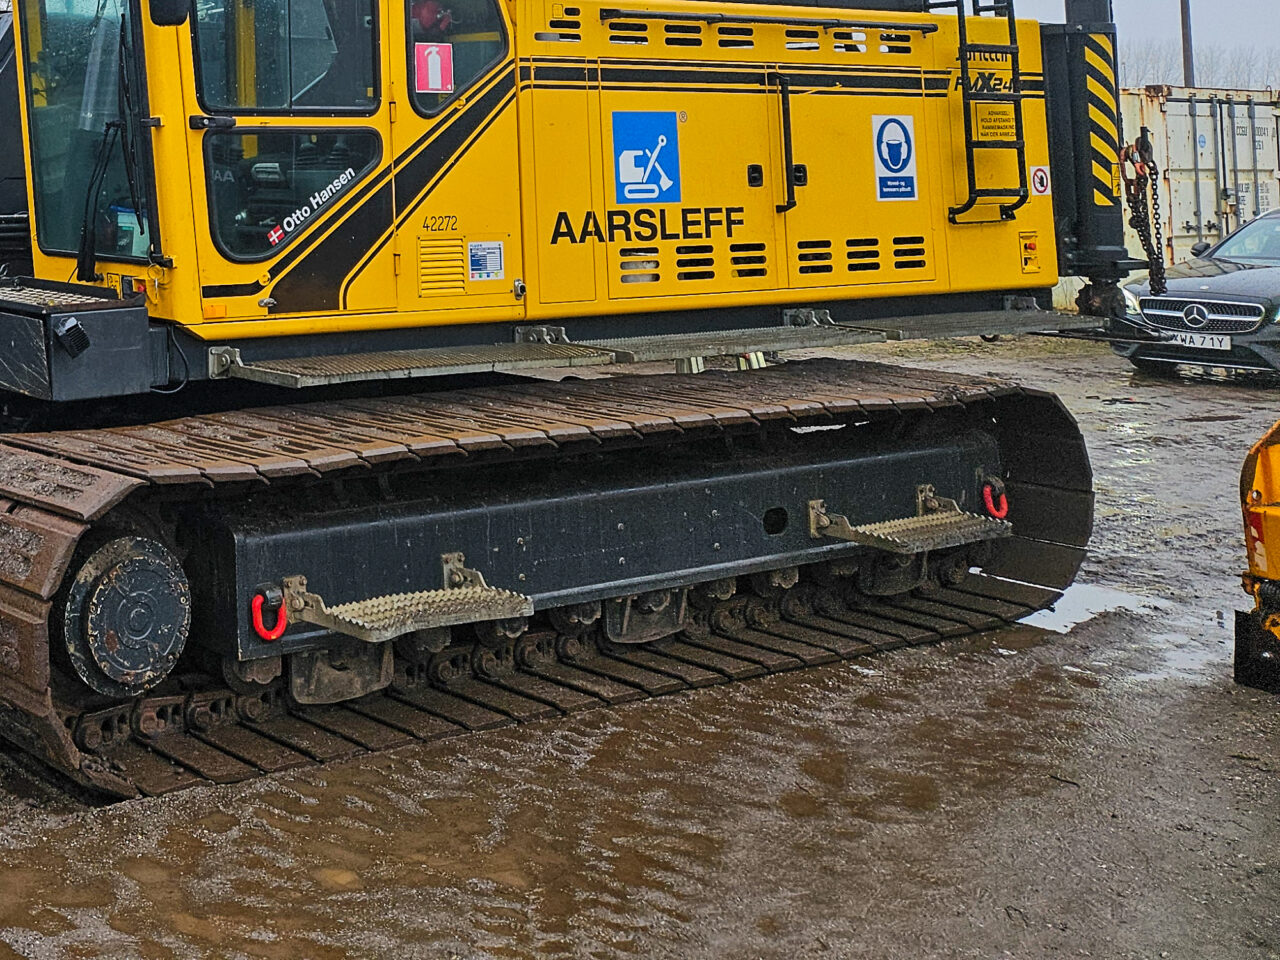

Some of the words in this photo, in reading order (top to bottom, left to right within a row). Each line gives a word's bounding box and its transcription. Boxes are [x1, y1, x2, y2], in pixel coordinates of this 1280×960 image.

[283, 206, 311, 232] Otto
[310, 167, 356, 209] Hansen
[422, 215, 458, 232] 42272
[550, 207, 745, 244] AARSLEFF
